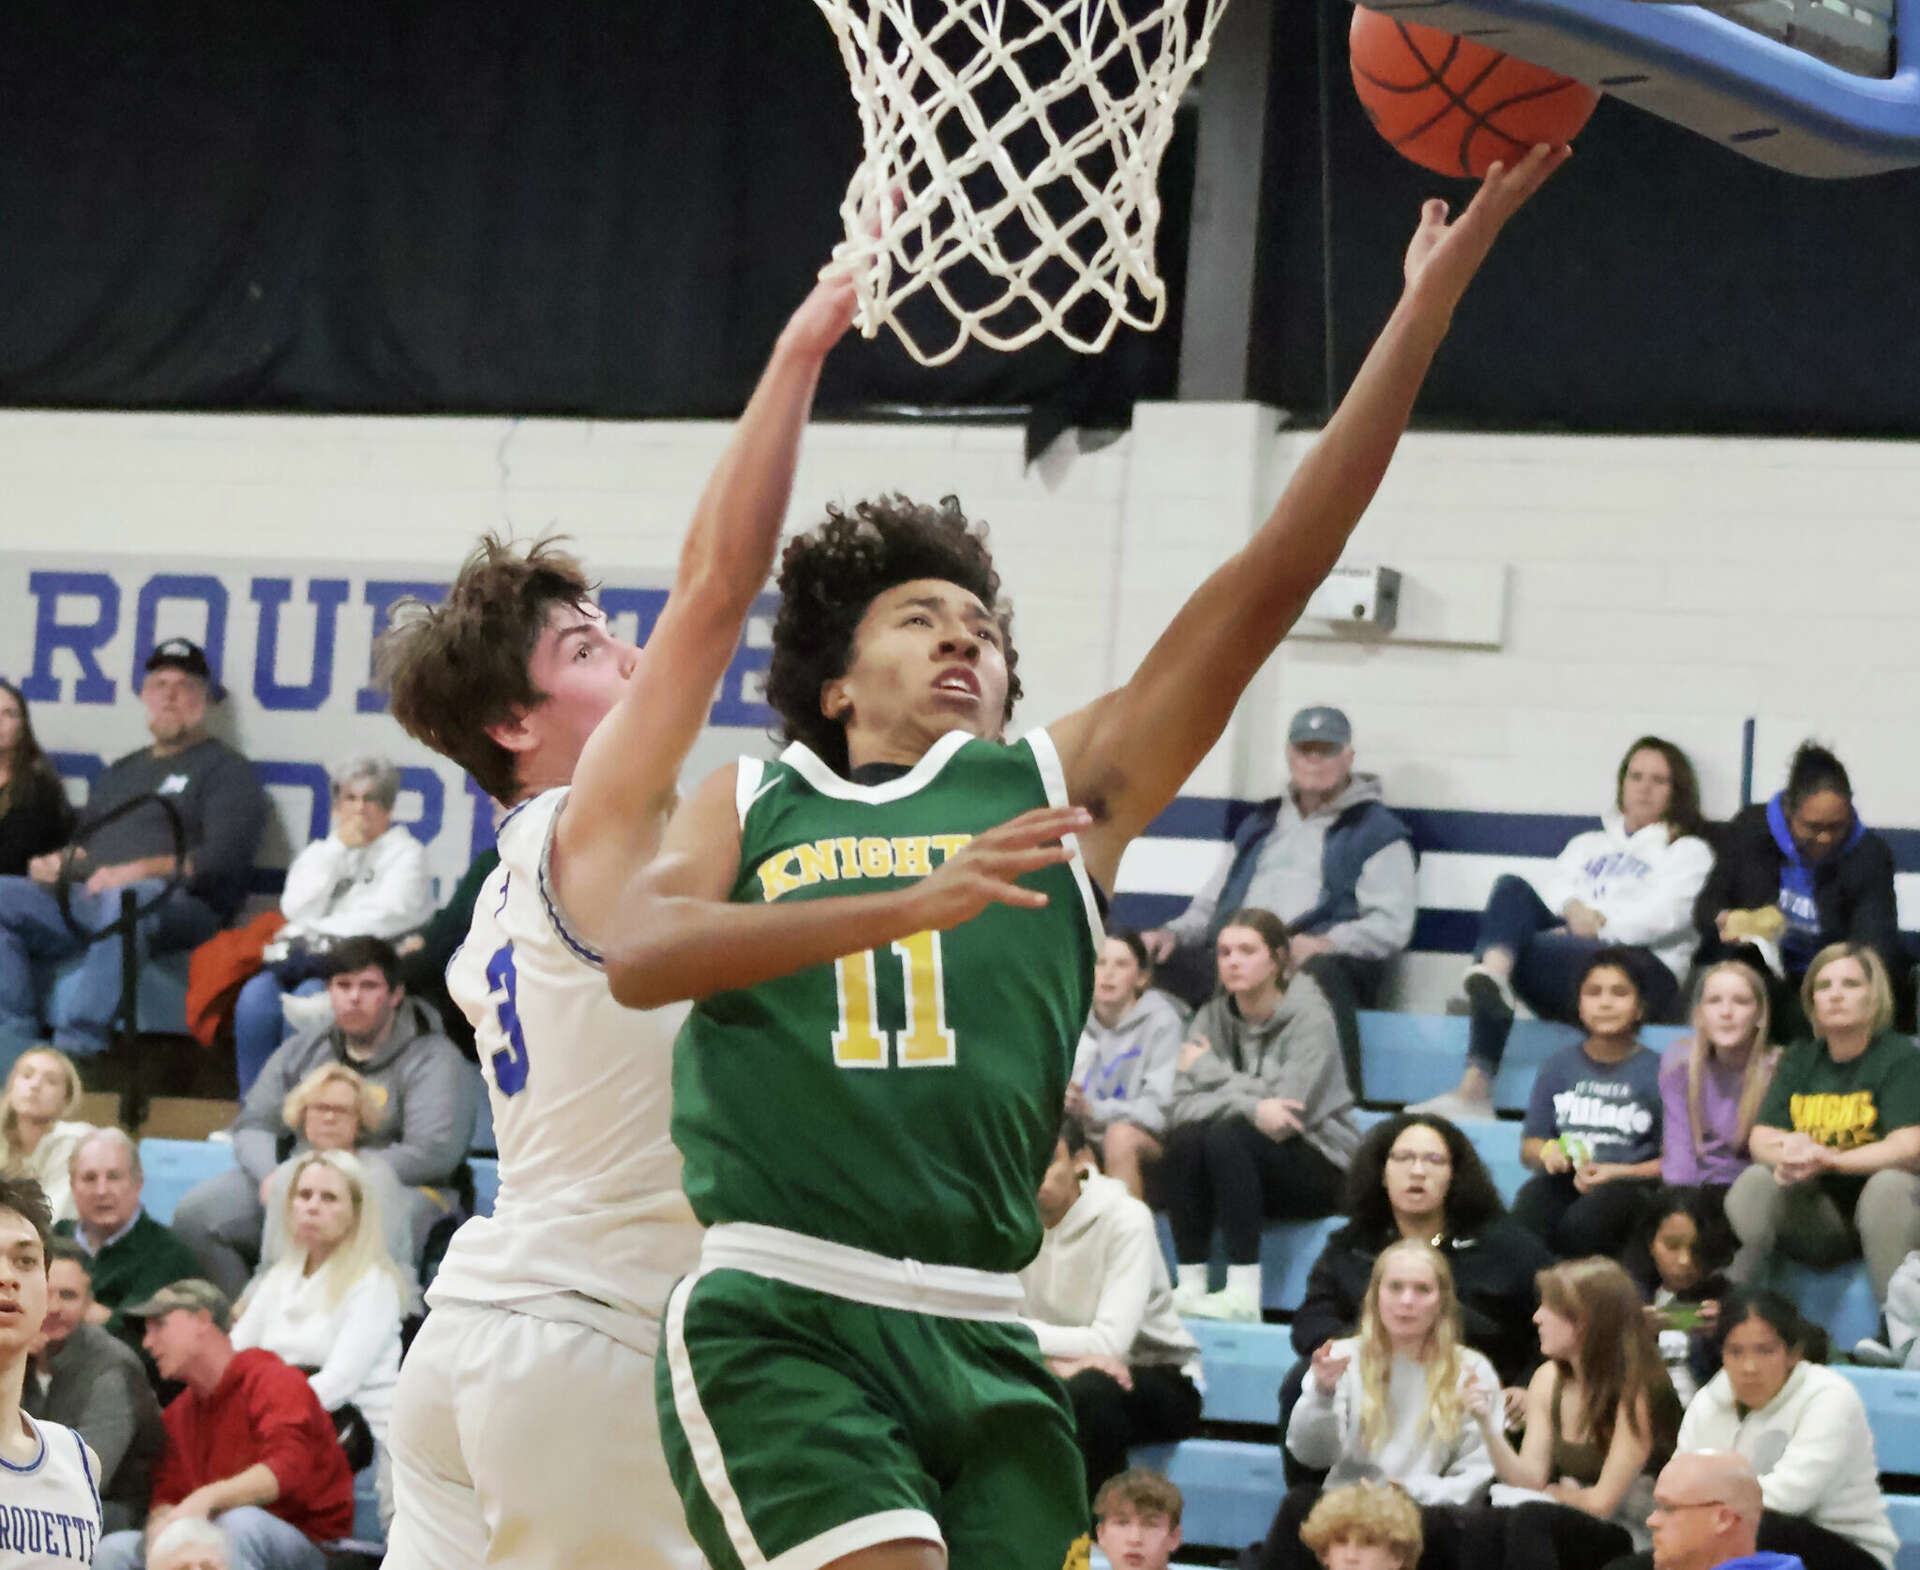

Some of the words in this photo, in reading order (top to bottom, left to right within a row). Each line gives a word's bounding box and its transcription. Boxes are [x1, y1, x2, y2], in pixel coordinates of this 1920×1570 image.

[757, 834, 972, 902] KNIGHT
[487, 939, 529, 1098] 3
[831, 929, 956, 1069] 11
